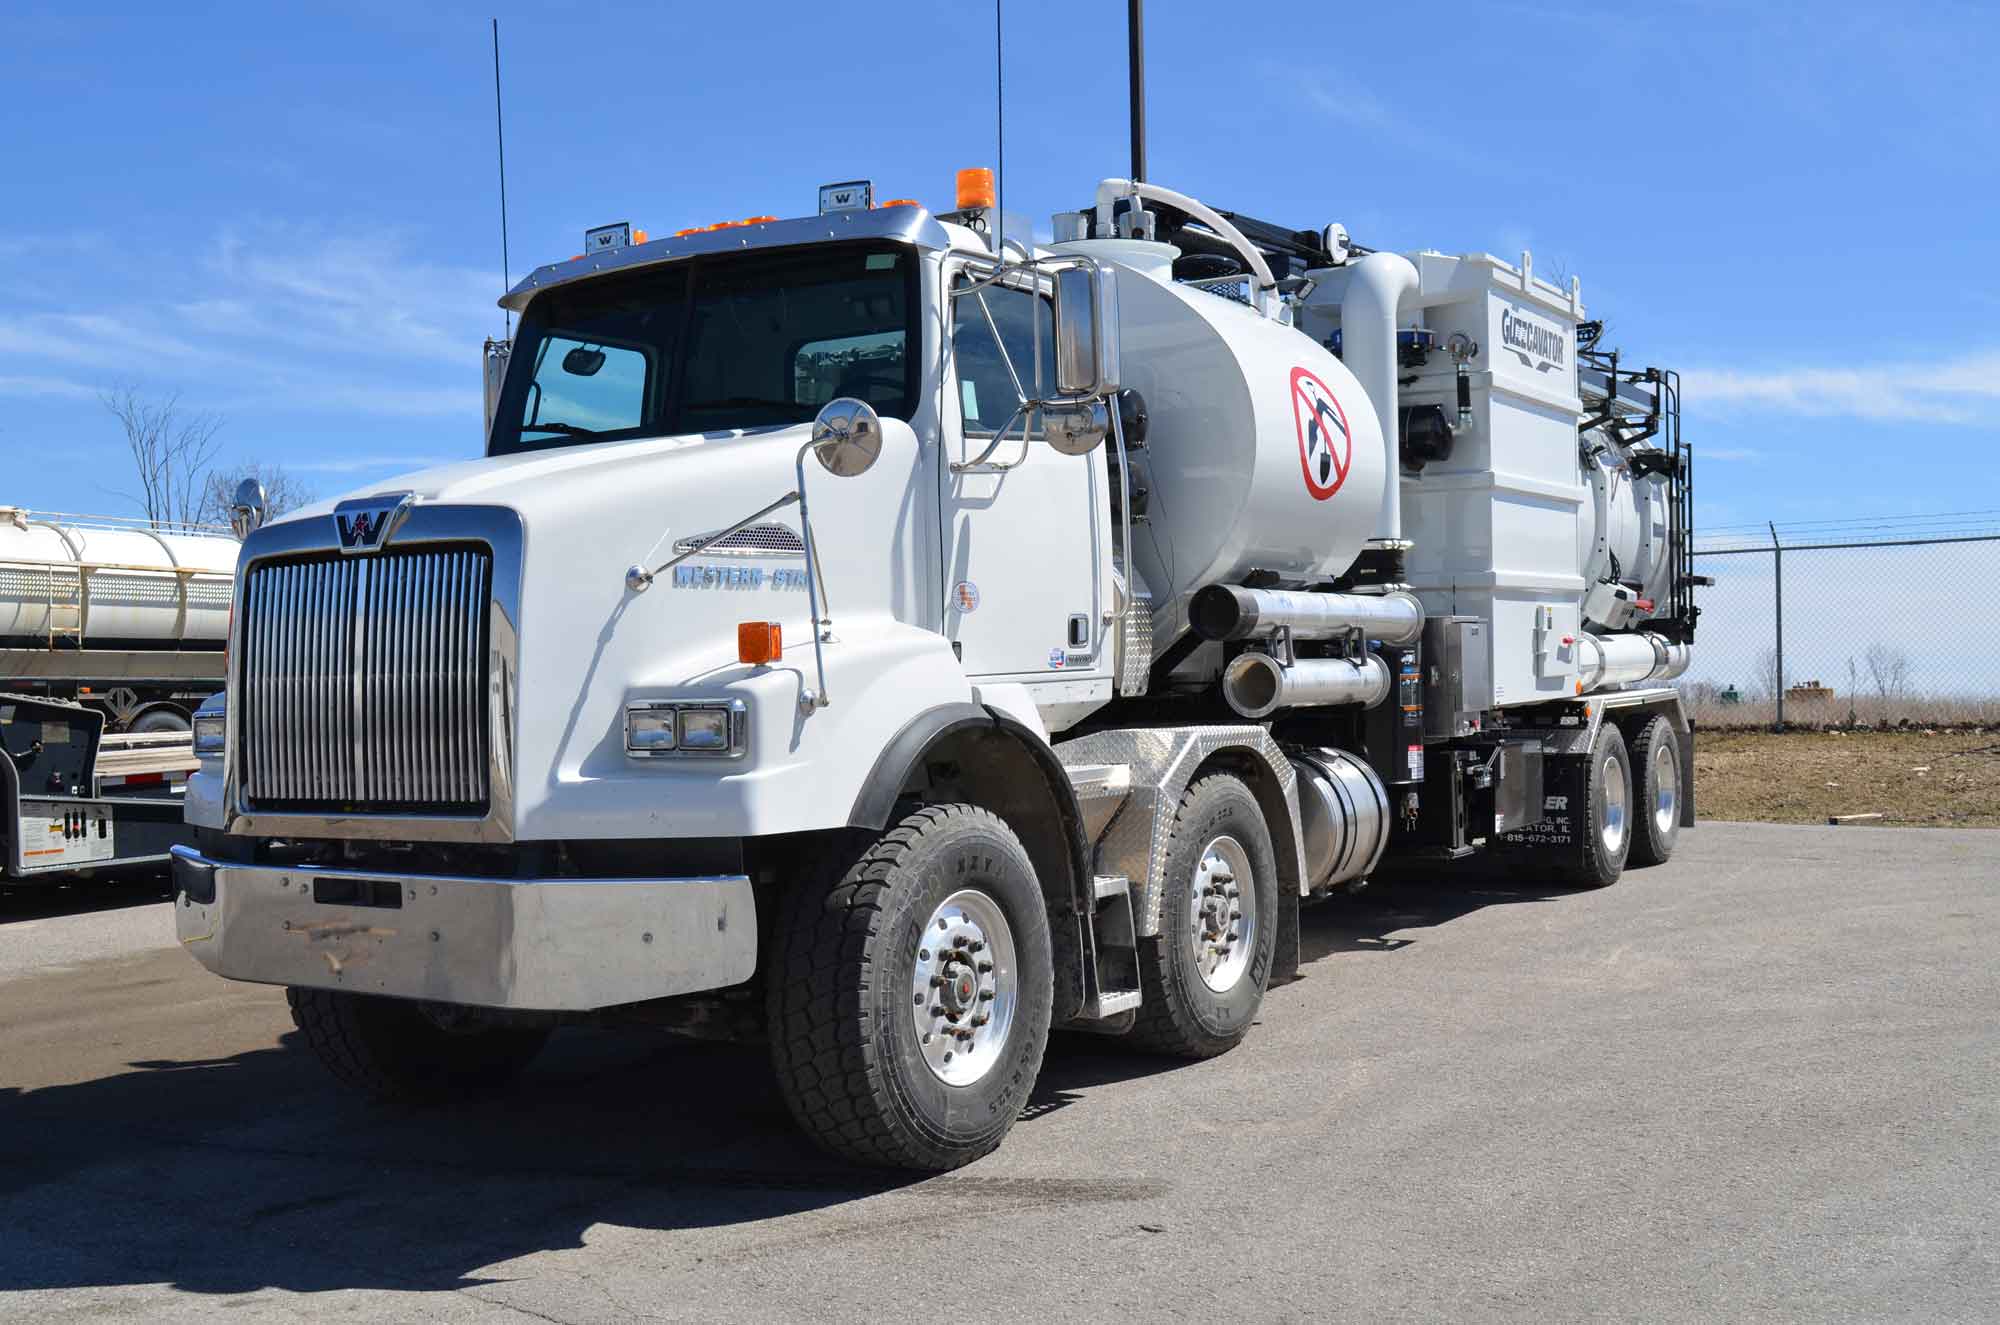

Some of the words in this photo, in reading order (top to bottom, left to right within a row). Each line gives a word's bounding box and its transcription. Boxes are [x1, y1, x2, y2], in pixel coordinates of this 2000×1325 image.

[672, 565, 763, 589] WESTERN
[772, 567, 809, 588] STA
[1544, 796, 1568, 810] ER
[1561, 824, 1570, 833] IL
